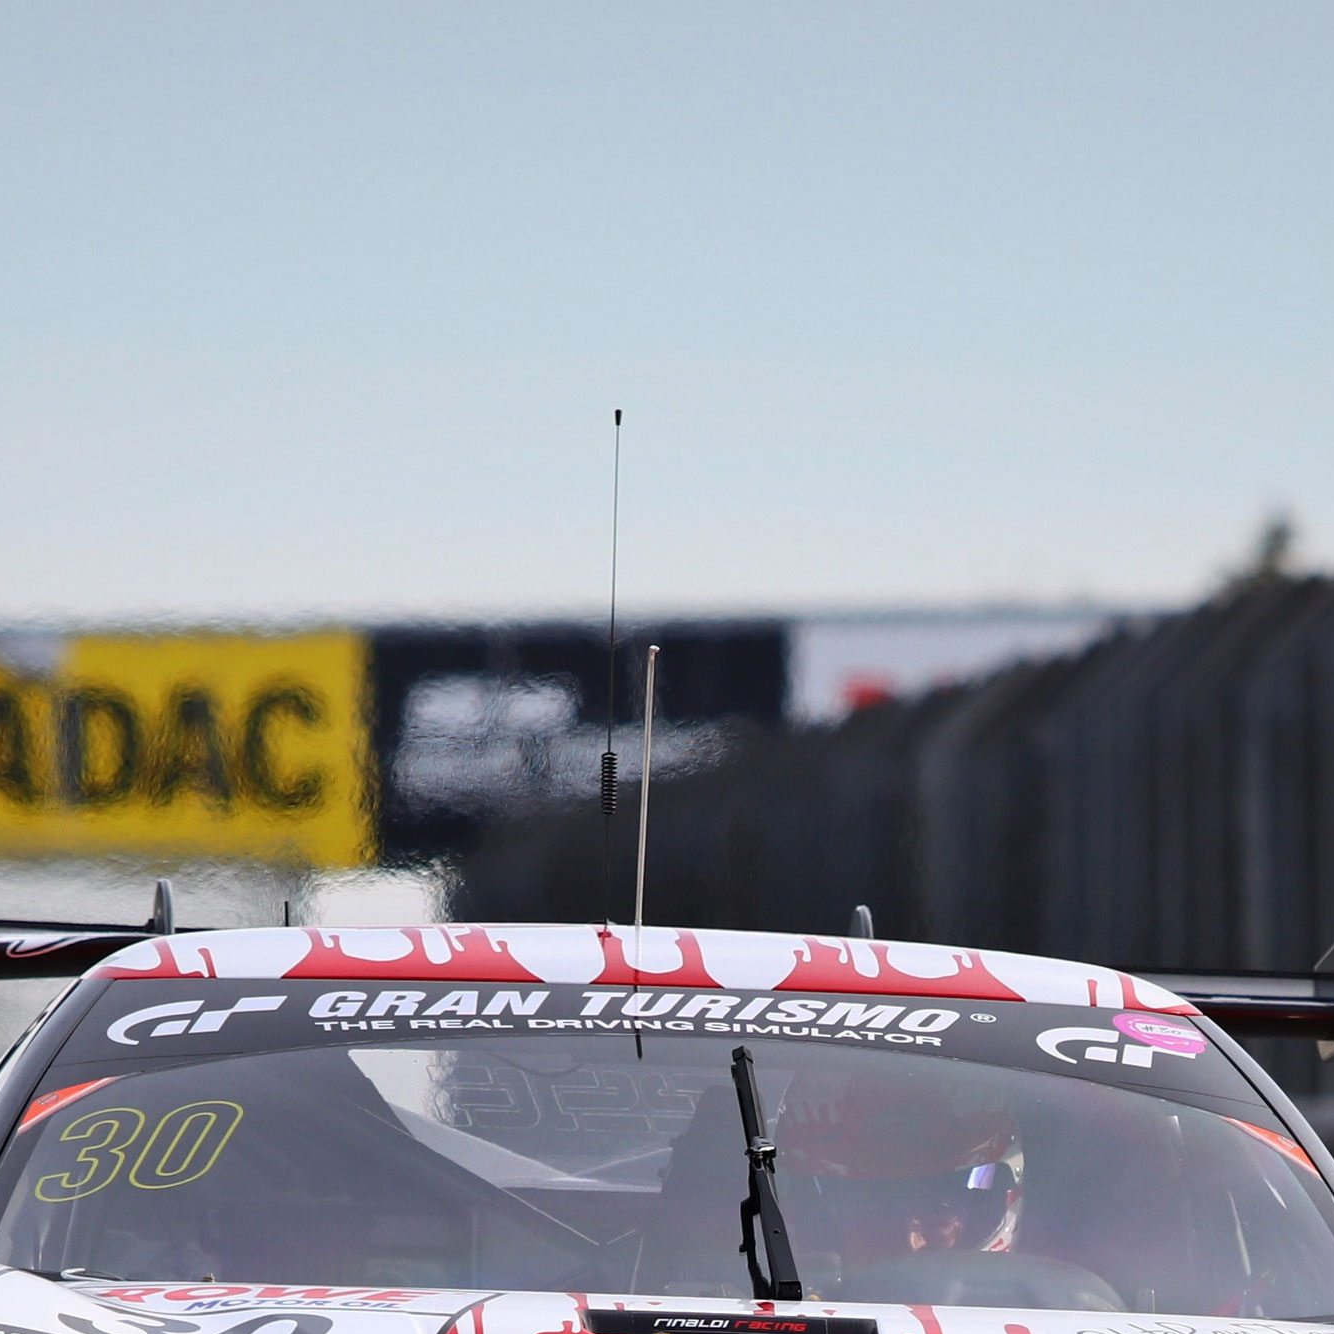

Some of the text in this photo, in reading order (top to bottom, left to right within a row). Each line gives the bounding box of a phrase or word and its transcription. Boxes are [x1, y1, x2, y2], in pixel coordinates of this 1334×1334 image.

[308, 990, 551, 1018] GRAN
[580, 991, 960, 1033] TURISMO
[315, 1019, 942, 1046] THE REAL DRIVING SIMULATOR
[35, 1100, 244, 1203] 30
[97, 1286, 439, 1303] ROWE
[184, 1299, 405, 1312] MOTOR OIL
